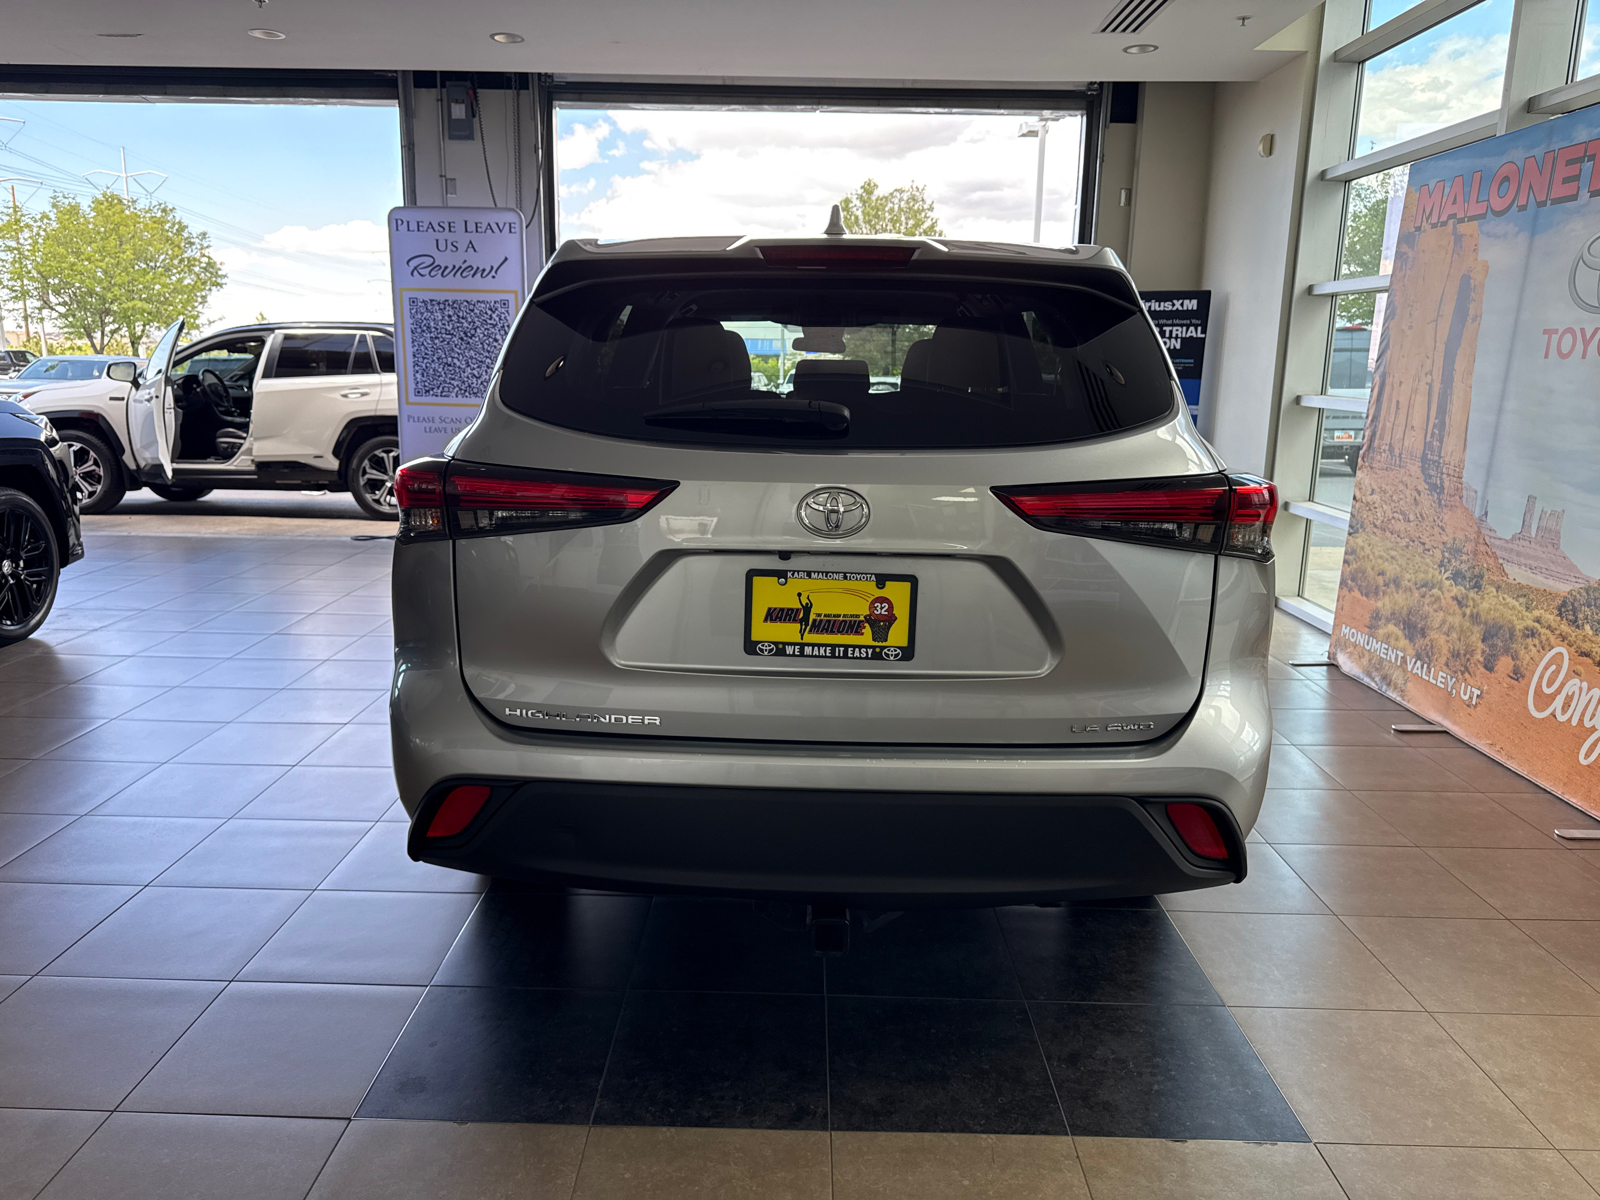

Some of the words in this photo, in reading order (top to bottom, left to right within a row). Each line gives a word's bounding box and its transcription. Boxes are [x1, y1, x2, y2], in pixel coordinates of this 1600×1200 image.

[394, 218, 457, 233] PLEASE
[463, 219, 517, 234] LEAVE
[464, 239, 479, 253] A
[406, 253, 509, 280] Review!
[1142, 299, 1197, 311] iriusXM
[1163, 326, 1206, 338] TRIAL
[1542, 326, 1600, 361] TOY
[787, 571, 809, 580] KARL
[811, 572, 845, 580] MALONE
[846, 573, 877, 582] TOYOTA
[763, 607, 803, 624] KARL
[874, 602, 889, 615] 32
[807, 618, 867, 636] MALONE
[785, 645, 801, 655] WE
[804, 645, 832, 657] MAKE
[835, 647, 845, 657] IT
[847, 647, 874, 658] EASY
[1340, 624, 1404, 666] MONUMENT
[1406, 654, 1457, 698] VALLEY,
[1460, 682, 1482, 705] UT
[505, 707, 662, 726] HIGHLANDER
[1071, 724, 1100, 733] LE
[1106, 721, 1154, 732] AWD
